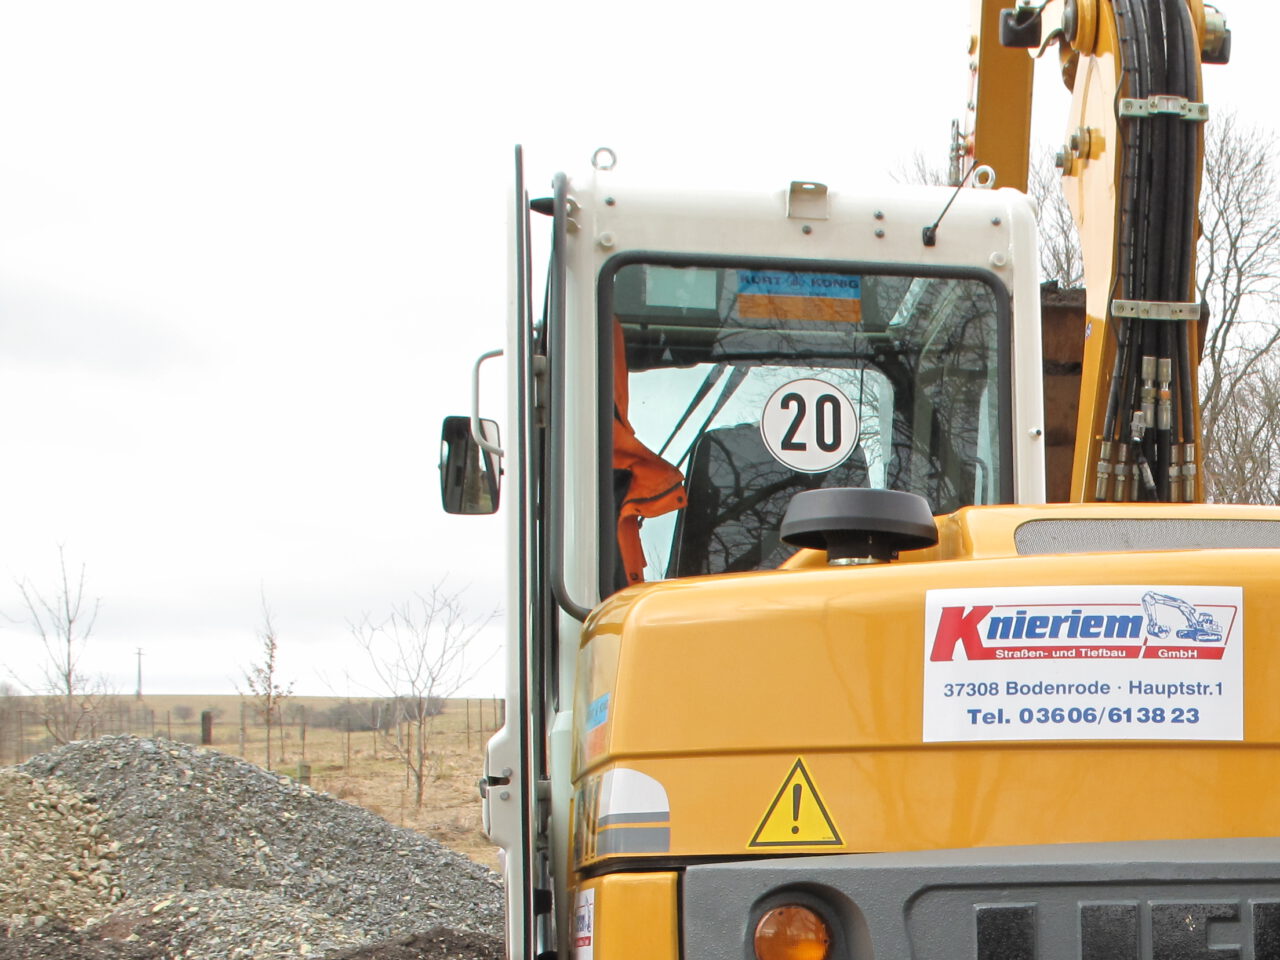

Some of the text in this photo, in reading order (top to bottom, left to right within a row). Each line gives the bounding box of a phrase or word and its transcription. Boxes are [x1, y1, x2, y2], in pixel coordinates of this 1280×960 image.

[780, 391, 842, 453] 20
[930, 605, 1144, 662] Knieriem
[995, 648, 1198, 659] Straßen- und Tiefbau GmbH
[944, 682, 1000, 697] 37308
[1005, 681, 1111, 696] Bodenrode
[966, 708, 1011, 724] Tel.
